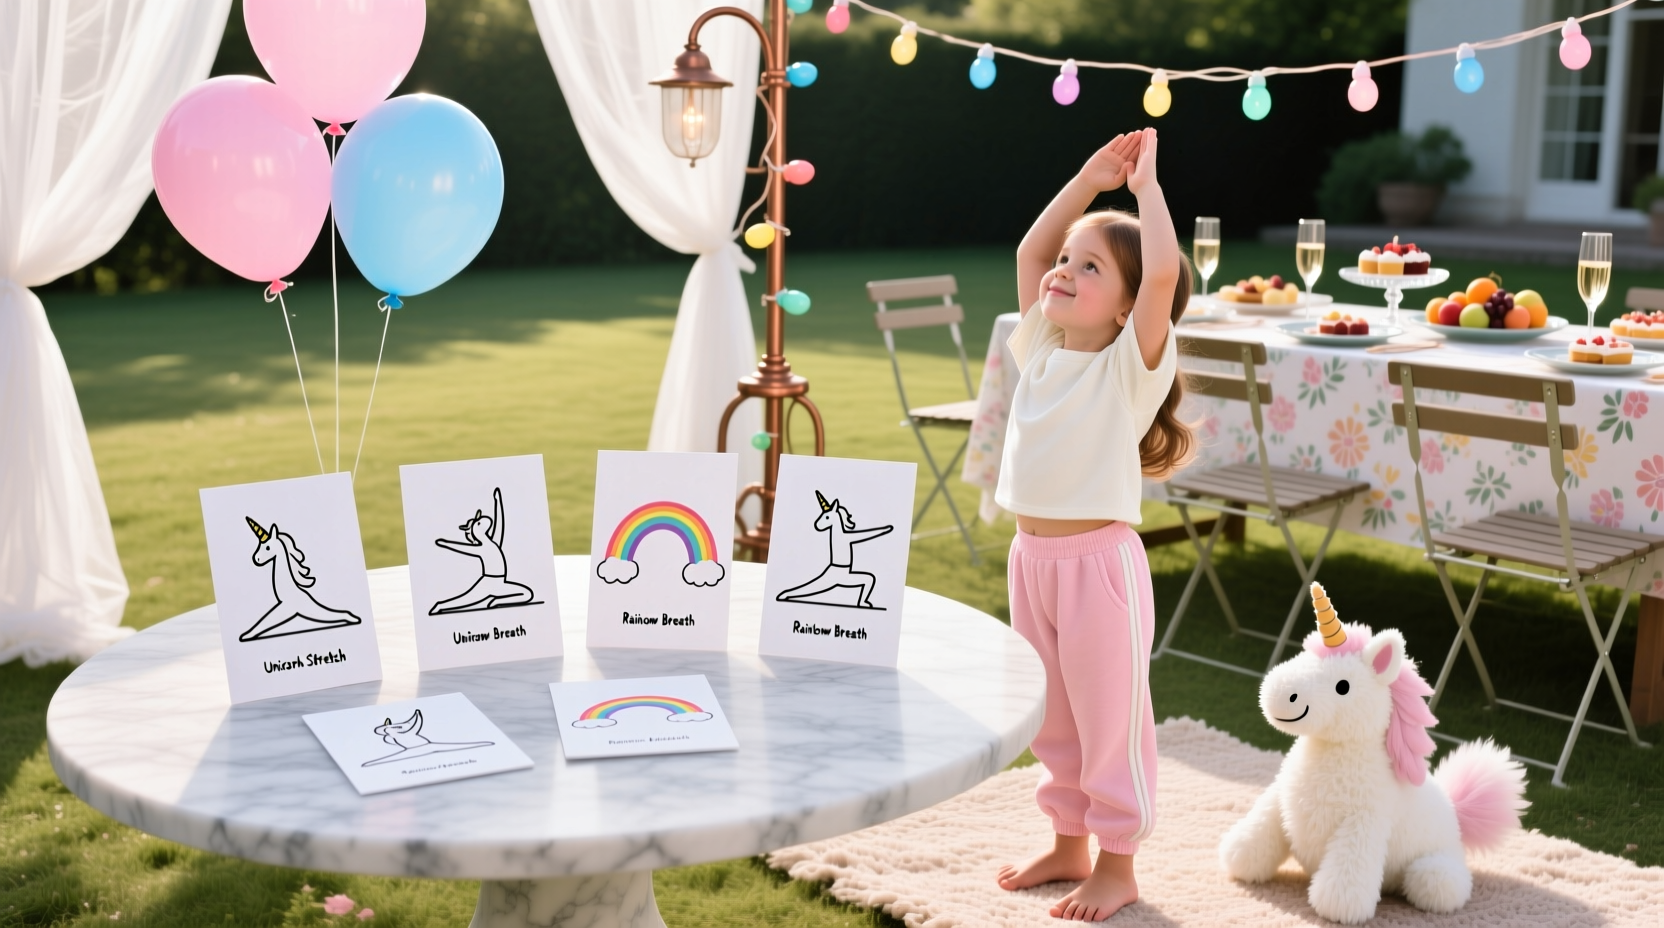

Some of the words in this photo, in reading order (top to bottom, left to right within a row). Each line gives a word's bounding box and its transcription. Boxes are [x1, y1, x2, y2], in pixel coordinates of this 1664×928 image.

[661, 613, 695, 627] Breath
[493, 624, 527, 640] Breath
[834, 624, 868, 641] Breath
